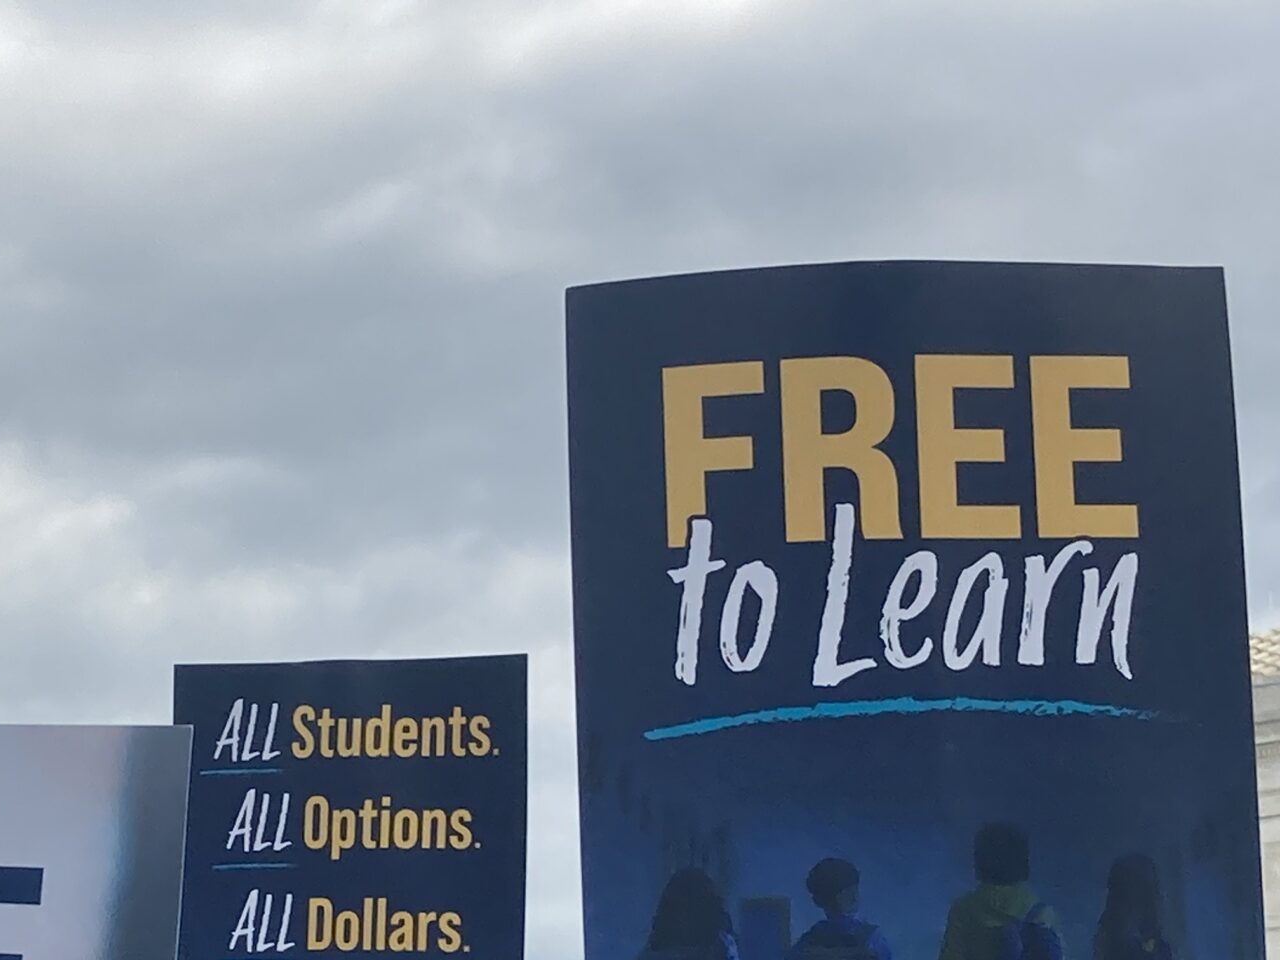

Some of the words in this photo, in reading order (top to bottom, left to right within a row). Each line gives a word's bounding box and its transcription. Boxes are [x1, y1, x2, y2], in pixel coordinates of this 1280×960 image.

[661, 354, 1139, 548] FREE
[666, 518, 778, 686] to
[812, 503, 1139, 687] Learn
[214, 698, 281, 762] ALL
[291, 704, 500, 759] Students.
[226, 788, 293, 852] ALL
[303, 795, 482, 860] Options.
[229, 889, 295, 952] ALL
[306, 897, 471, 953] Dollars.
